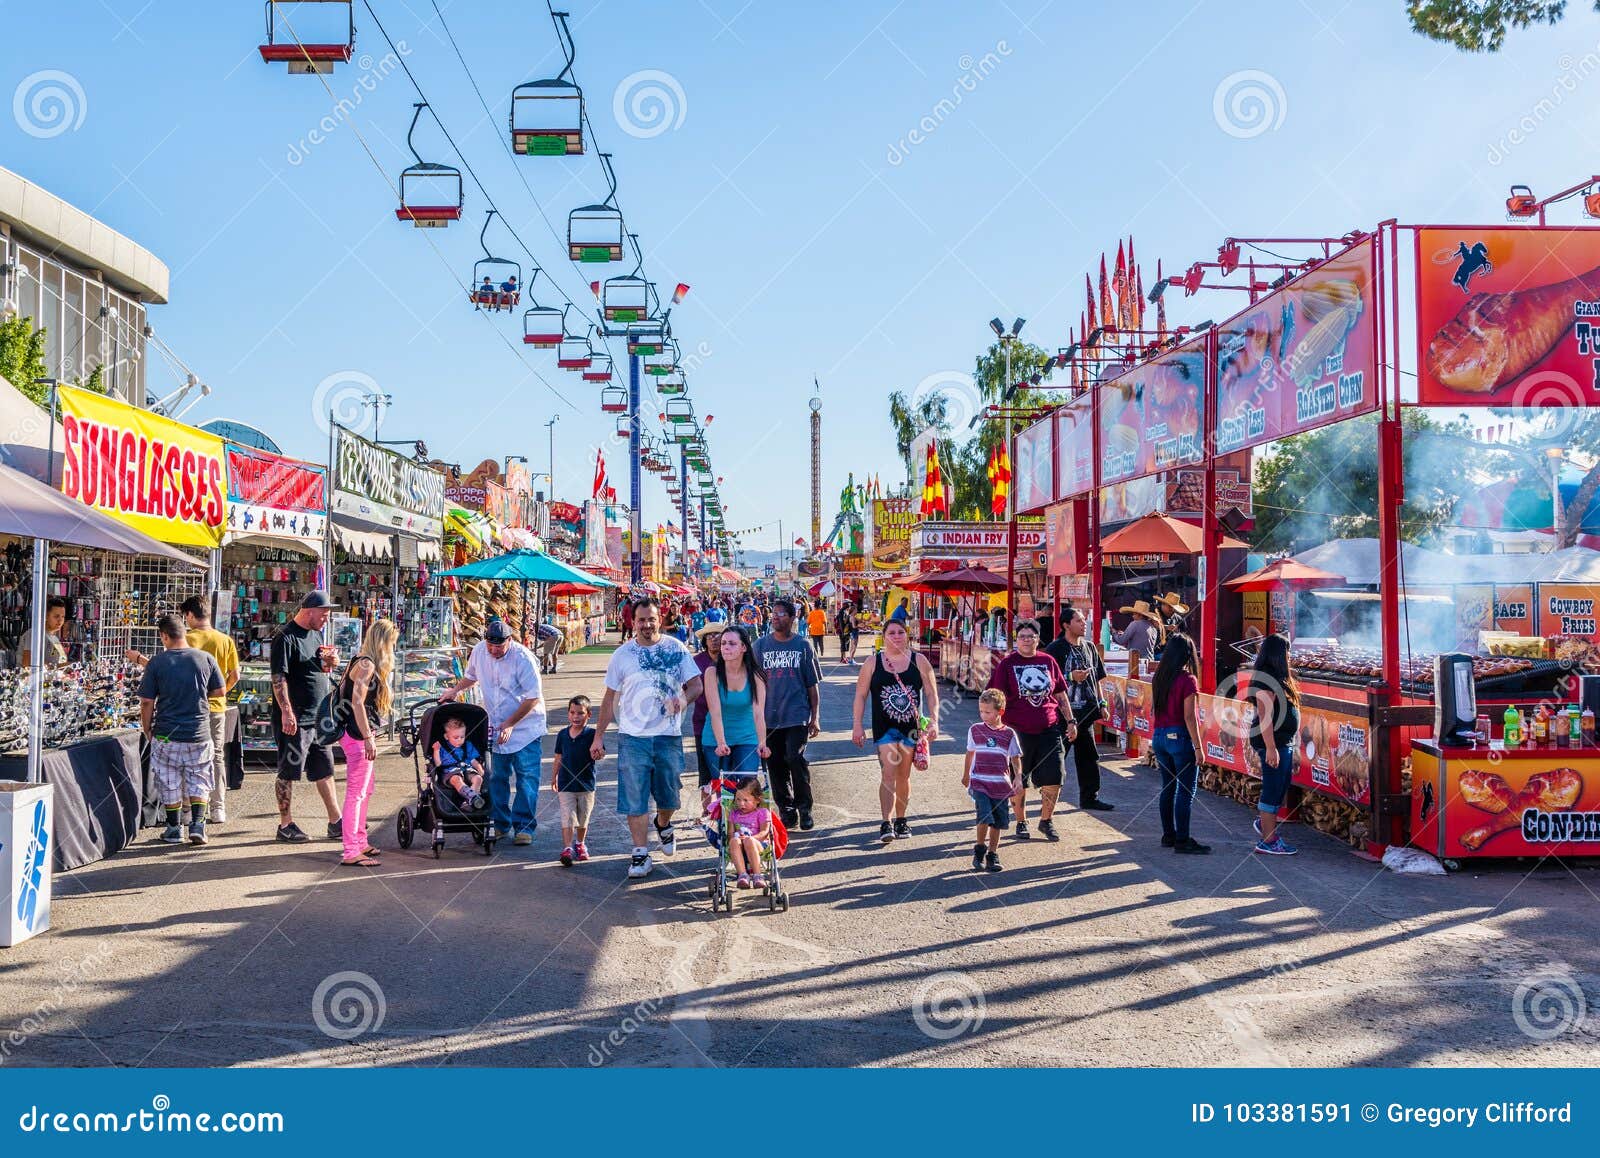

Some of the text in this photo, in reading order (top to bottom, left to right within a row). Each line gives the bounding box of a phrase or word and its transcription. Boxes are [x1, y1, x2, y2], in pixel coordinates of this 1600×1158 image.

[1296, 370, 1363, 423] ROASTED CORN
[62, 412, 225, 529] SUNGLASSES
[879, 510, 917, 525] Curly
[942, 533, 1041, 545] INDIAN FRY READ
[1549, 597, 1593, 615] COWBOY
[1561, 616, 1596, 634] FRIES
[775, 650, 802, 660] SARCASTIC
[763, 658, 794, 670] COMMENT
